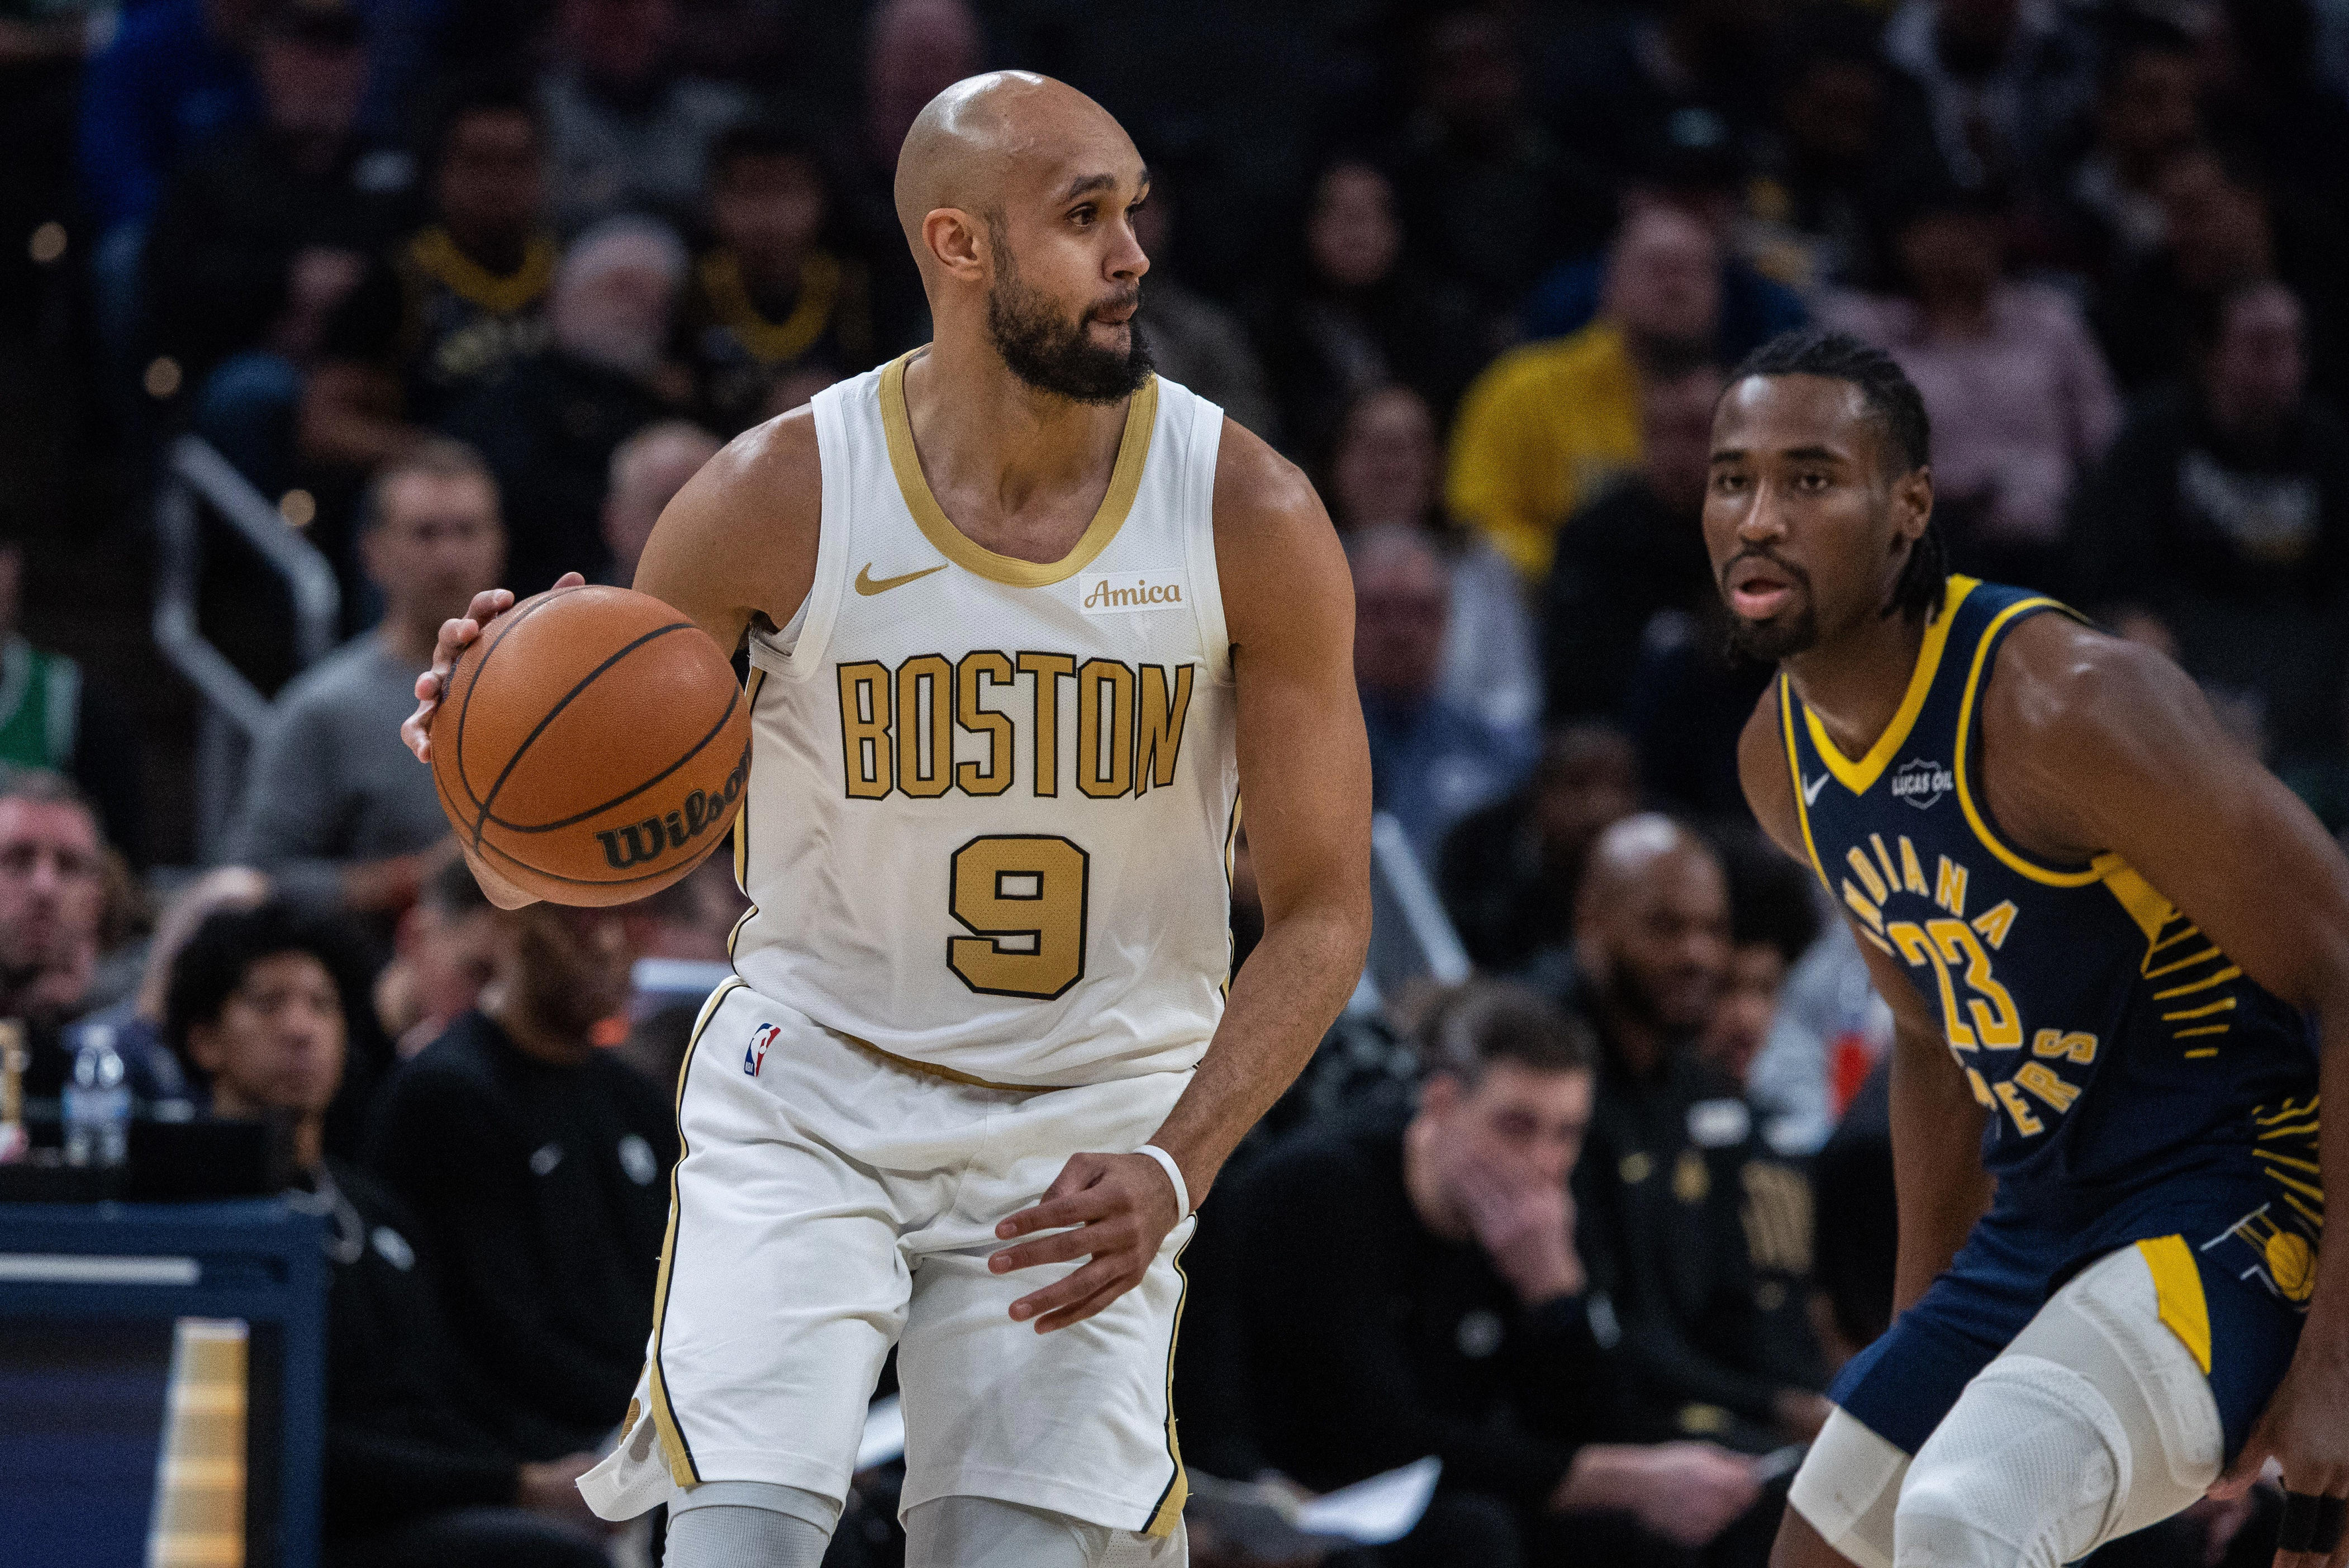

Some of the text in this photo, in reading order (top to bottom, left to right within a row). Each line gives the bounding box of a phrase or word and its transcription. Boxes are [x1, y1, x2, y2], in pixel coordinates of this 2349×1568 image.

[1084, 579, 1182, 609] Amica
[836, 649, 1195, 800] BOSTON
[1891, 769, 1954, 796] LUCAS OIL
[946, 834, 1091, 1001] 9
[1886, 918, 2024, 1053] 23
[745, 1061, 754, 1073] NBA
